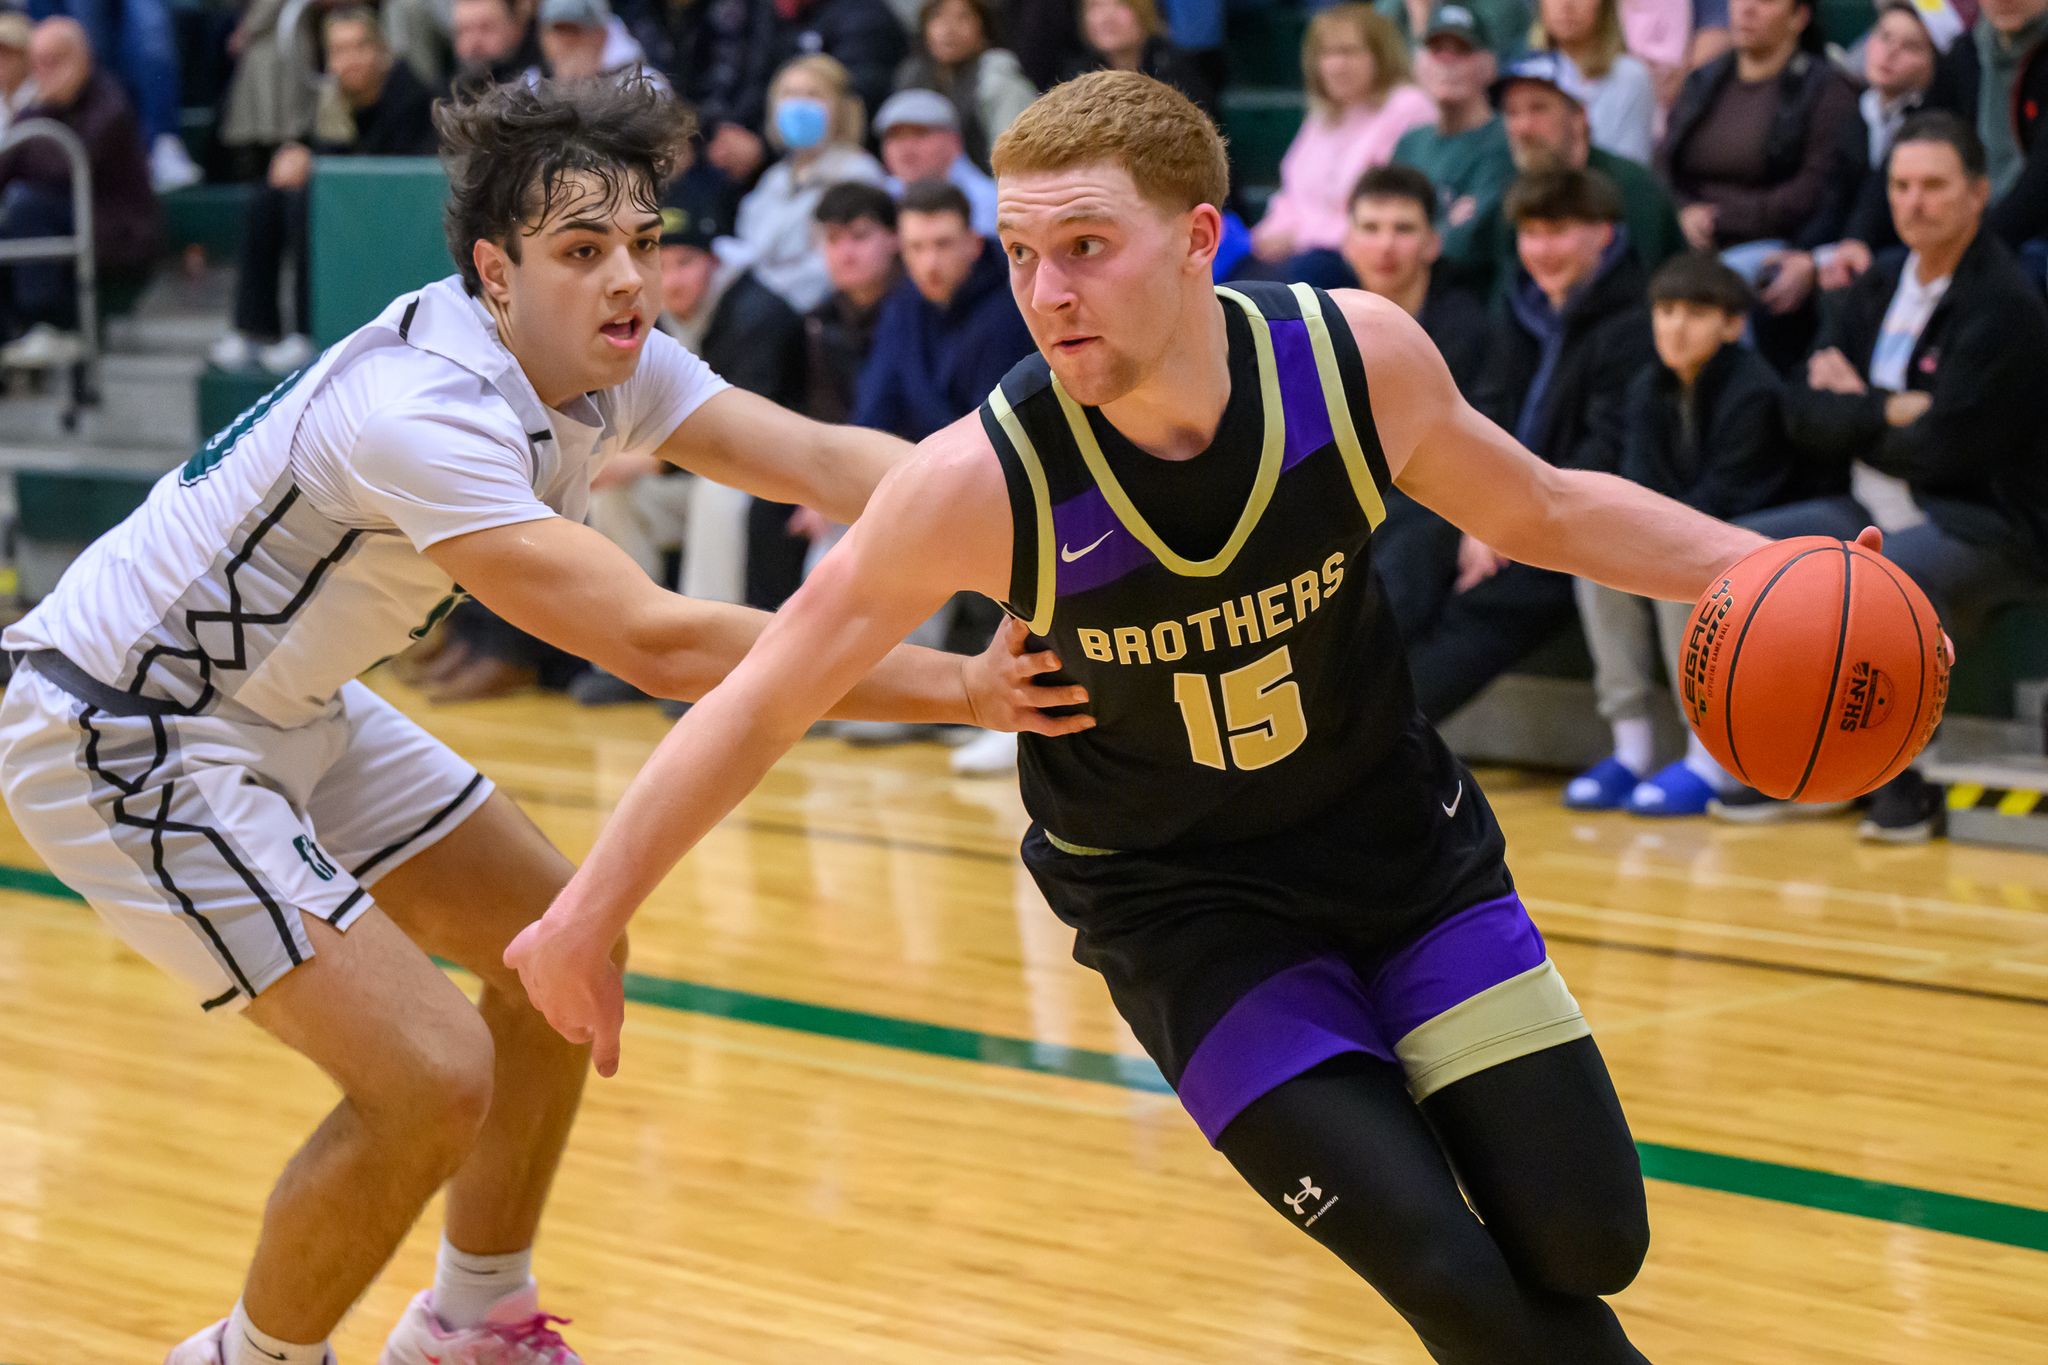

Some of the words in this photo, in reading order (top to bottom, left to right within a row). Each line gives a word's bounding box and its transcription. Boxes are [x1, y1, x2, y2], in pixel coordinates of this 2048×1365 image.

[1077, 551, 1345, 665] BROTHERS
[1684, 579, 1731, 728] LEGACY
[1711, 640, 1723, 663] GAME
[1719, 622, 1731, 641] BALL
[1173, 644, 1308, 771] 15
[1840, 678, 1867, 732] NFHS
